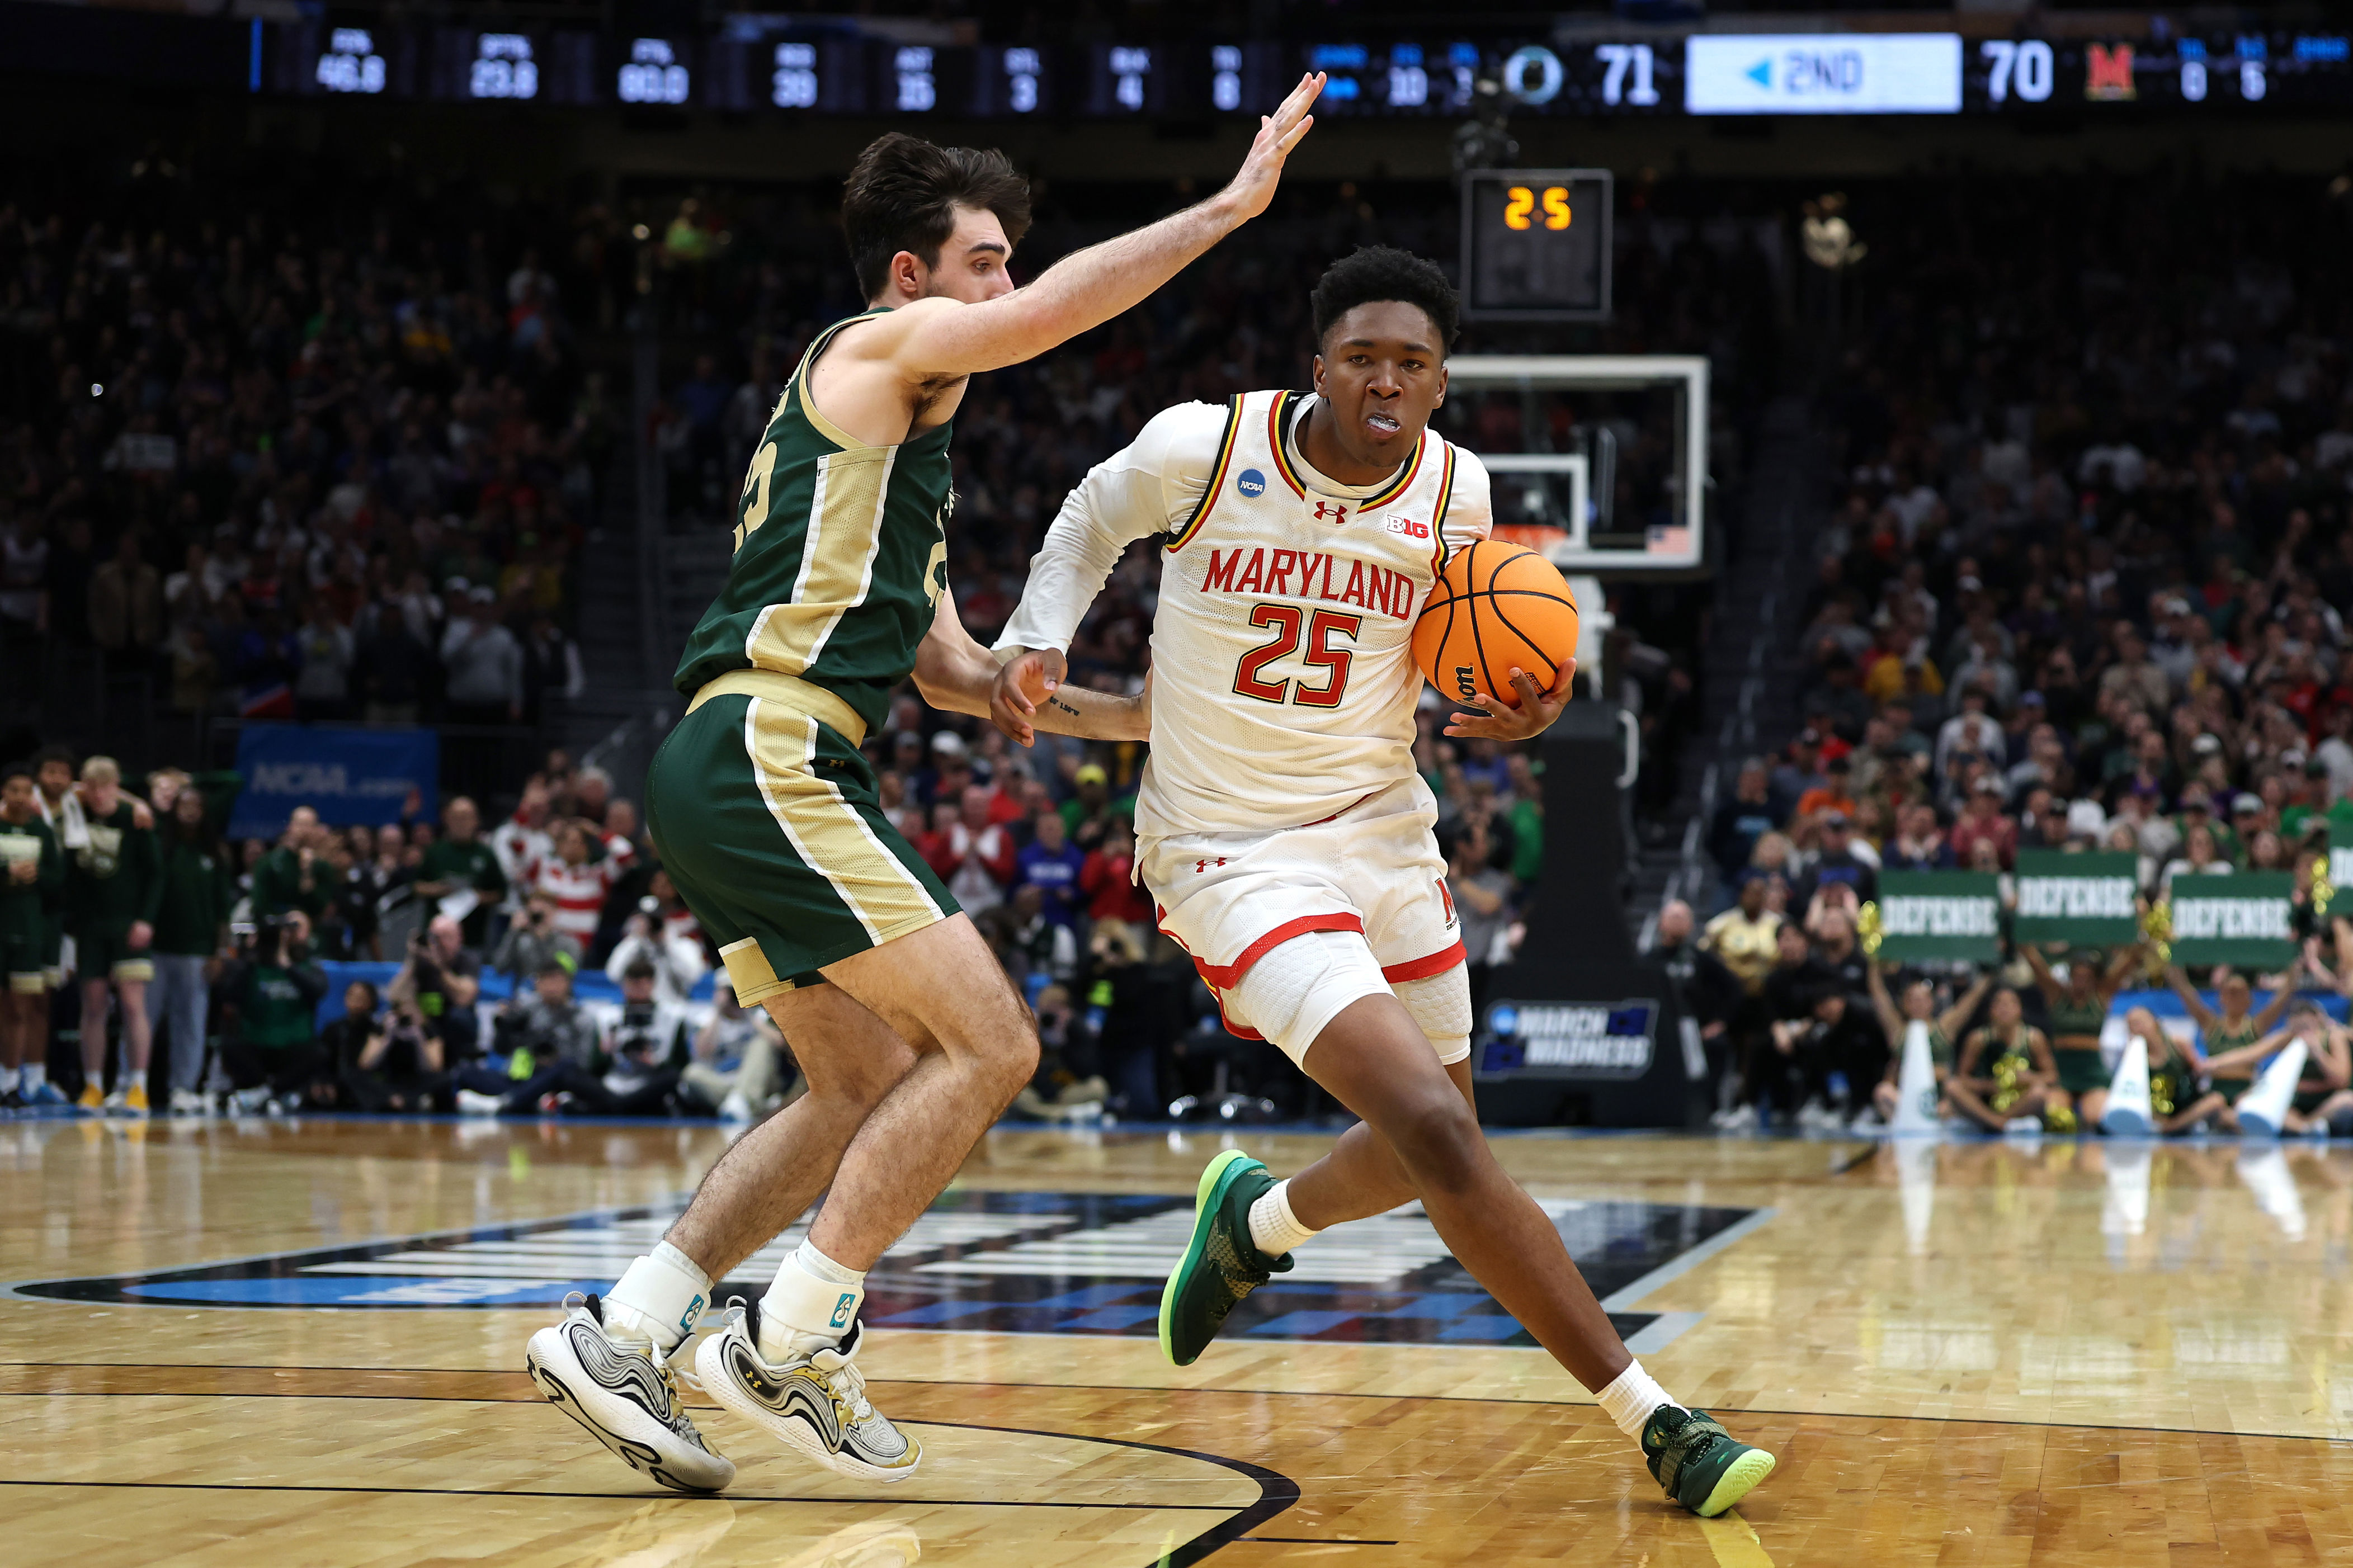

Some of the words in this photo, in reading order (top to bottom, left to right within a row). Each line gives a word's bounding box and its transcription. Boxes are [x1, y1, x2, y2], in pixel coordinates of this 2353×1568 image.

[1596, 44, 1659, 106] 71
[1785, 50, 1864, 94] 2ND
[1981, 40, 2054, 102] 70
[1240, 480, 1263, 492] NCAA
[1201, 548, 1414, 621] MARYLAND
[1232, 602, 1362, 708] 25
[1882, 896, 1998, 936] DEFENSE
[2017, 876, 2135, 917] DEFENSE
[2173, 897, 2291, 938] DEFENSE
[1515, 1007, 1610, 1036] MARCH
[1524, 1036, 1650, 1066] MADNESS
